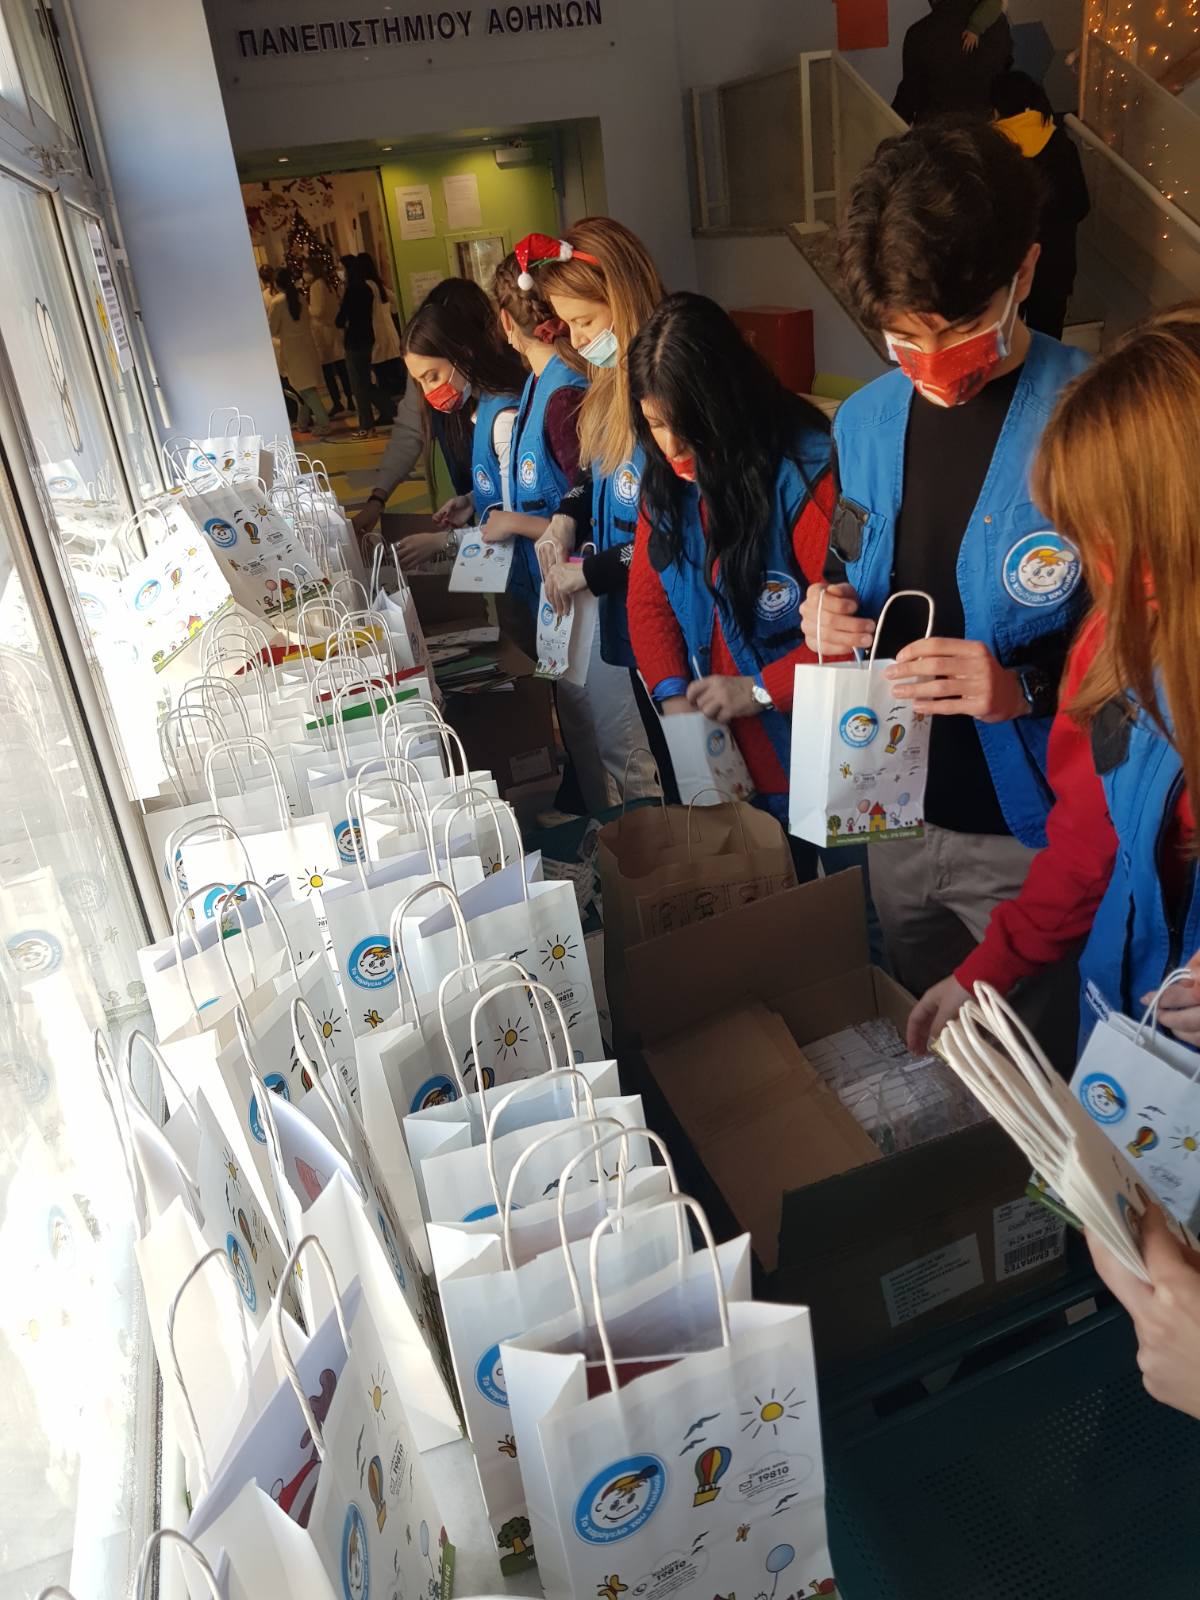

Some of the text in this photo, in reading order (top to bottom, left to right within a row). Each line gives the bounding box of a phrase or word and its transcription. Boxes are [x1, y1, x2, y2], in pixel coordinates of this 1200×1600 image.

[238, 0, 602, 57] ΠΑΝΕΠΙΣΤΗΜΙΟΥ ΑΘΗΝΩΝ
[758, 1466, 790, 1482] 19810
[656, 1560, 686, 1582] 19810
